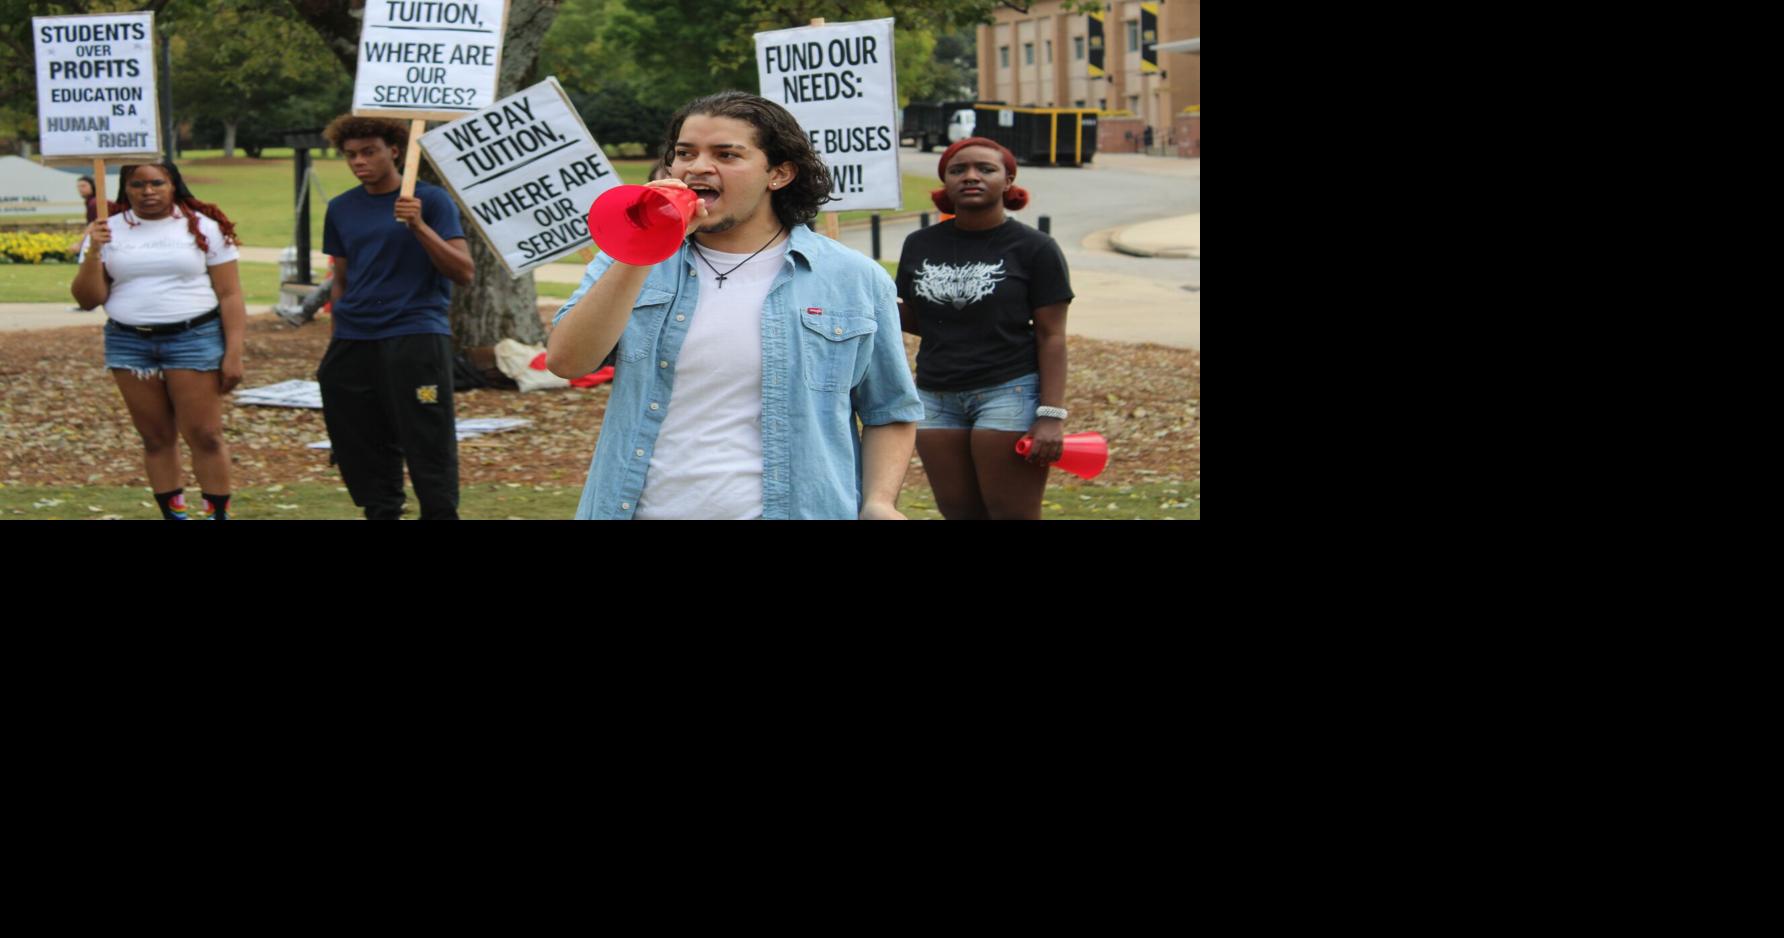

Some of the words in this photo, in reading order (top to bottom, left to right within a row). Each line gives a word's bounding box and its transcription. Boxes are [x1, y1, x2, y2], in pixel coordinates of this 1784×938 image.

[386, 0, 484, 28] TUITION,
[40, 22, 145, 43] STUDENTS
[76, 44, 112, 57] OVER
[365, 41, 446, 64] WHERE
[449, 44, 495, 66] ARE
[765, 41, 824, 74] FUND
[828, 35, 878, 67] OUR
[49, 58, 140, 80] PROFITS
[406, 66, 447, 84] OUR
[51, 86, 143, 103] EDUCATION
[373, 85, 477, 106] SERVICES?
[782, 70, 864, 104] NEEDS:
[112, 103, 125, 116] IS
[128, 103, 137, 116] A
[46, 115, 110, 132] HUMAN
[443, 118, 491, 152] WE
[484, 96, 536, 136] PAY
[97, 131, 149, 148] RIGHT
[456, 120, 567, 177] TUITION,
[825, 125, 891, 154] BUSES
[471, 174, 562, 226] WHERE
[558, 153, 610, 192] ARE
[533, 197, 579, 227] OUR
